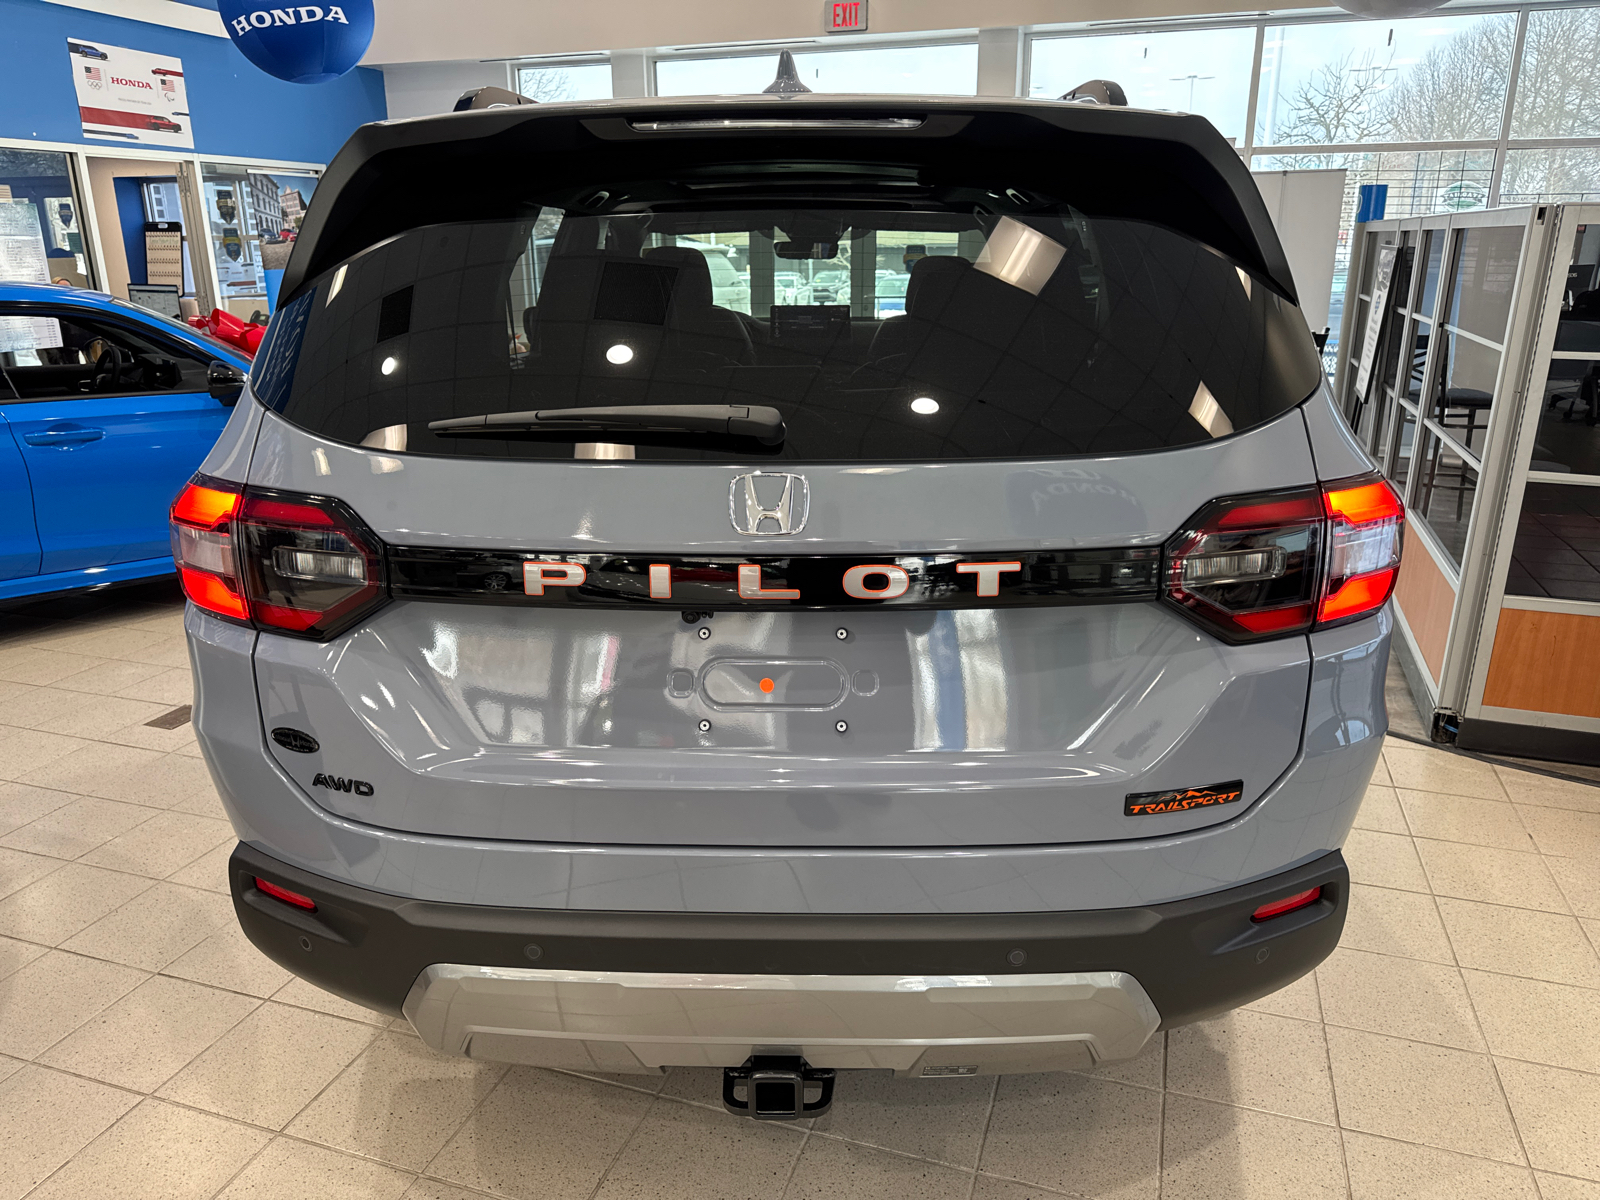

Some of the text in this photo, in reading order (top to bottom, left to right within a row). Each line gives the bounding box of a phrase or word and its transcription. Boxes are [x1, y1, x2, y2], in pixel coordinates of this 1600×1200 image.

[231, 6, 349, 37] HONDA
[833, 2, 860, 28] EXIT
[110, 76, 154, 91] HONDA
[523, 561, 1022, 600] PILOT
[312, 773, 374, 796] AWD
[1130, 791, 1240, 813] TRAILSPORT
